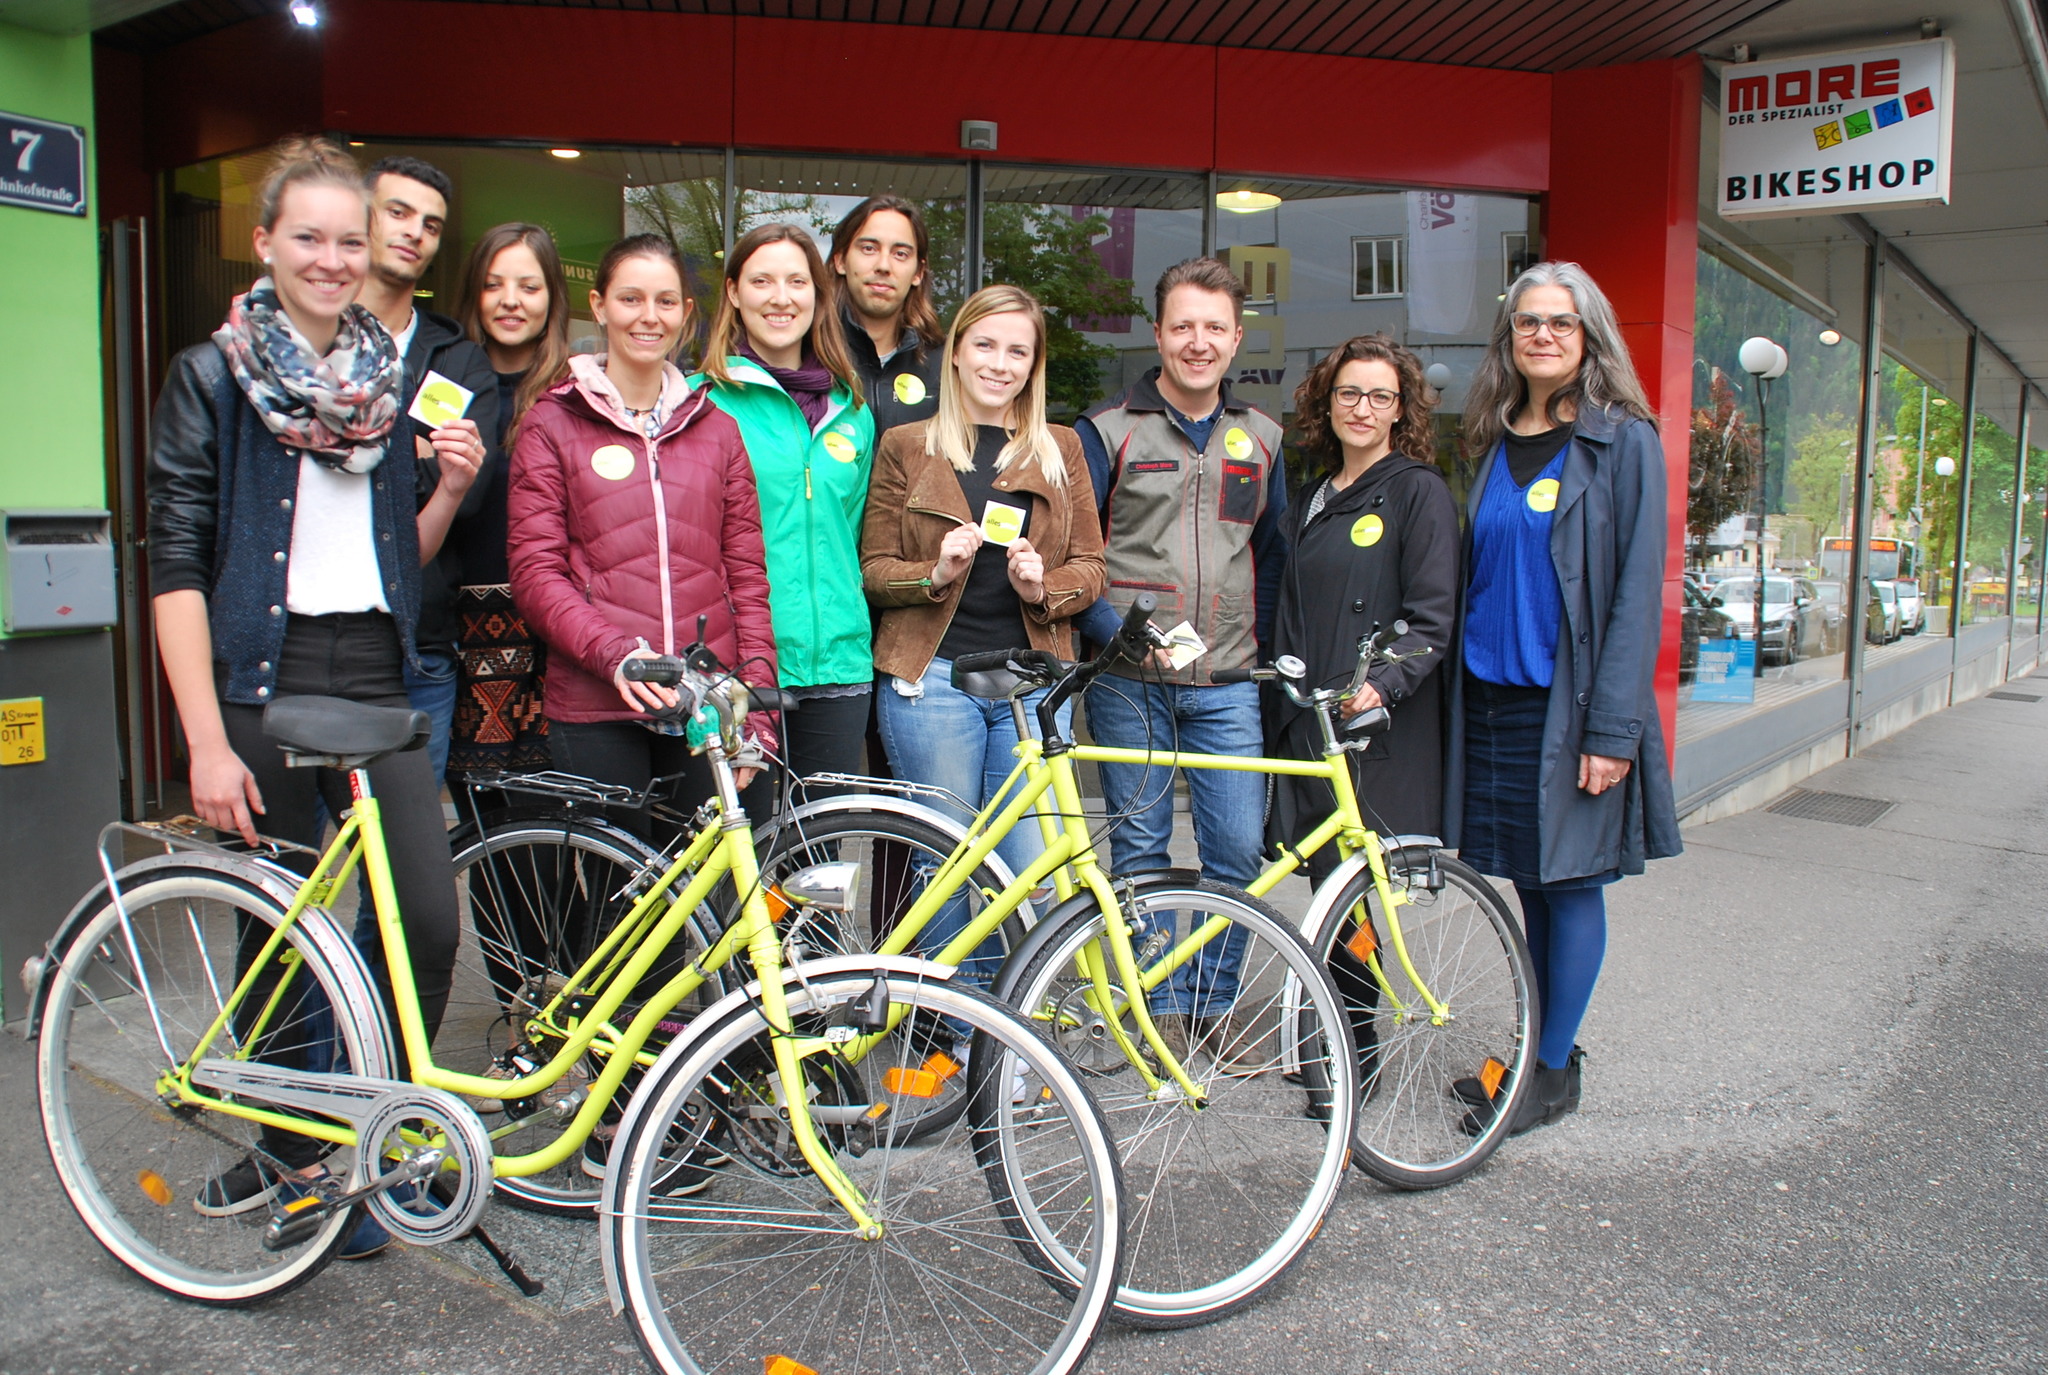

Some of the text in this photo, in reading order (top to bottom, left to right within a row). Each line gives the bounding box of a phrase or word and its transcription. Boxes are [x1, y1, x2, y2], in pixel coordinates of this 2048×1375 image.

[1728, 58, 1900, 113] MORE
[1728, 103, 1844, 126] DER SPEZIALIST
[11, 129, 42, 171] 7
[1726, 159, 1935, 202] BIKESHOP
[1, 709, 16, 722] AS
